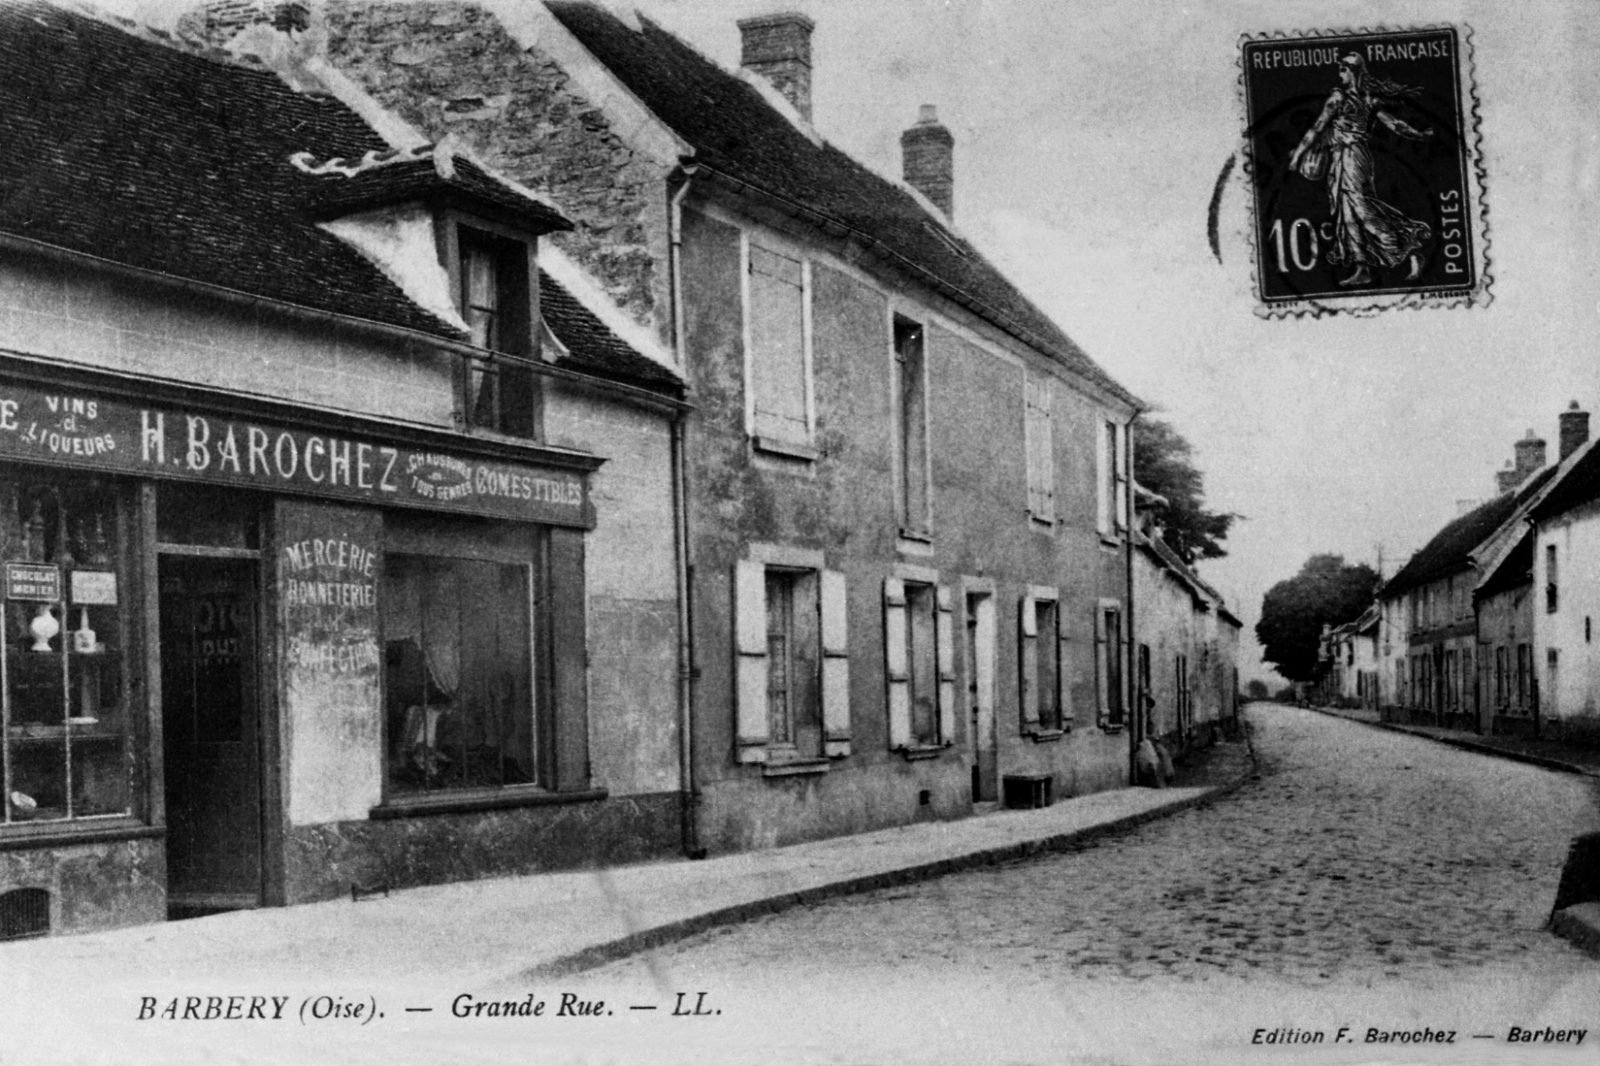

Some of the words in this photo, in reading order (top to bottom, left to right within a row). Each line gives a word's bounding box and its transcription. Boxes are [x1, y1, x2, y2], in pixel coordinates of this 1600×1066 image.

[1252, 46, 1340, 69] REPUBLIQUE
[1366, 39, 1449, 62] FRANÇAISE
[1440, 189, 1464, 274] POSTES
[45, 395, 98, 420] VINS
[21, 421, 116, 456] LIQUEURS
[411, 475, 435, 499] TOUS
[436, 480, 473, 501] GENRES
[475, 465, 583, 506] COMESTIBLES
[285, 538, 377, 577] MERCERIE
[287, 578, 377, 608] BONNETERIE
